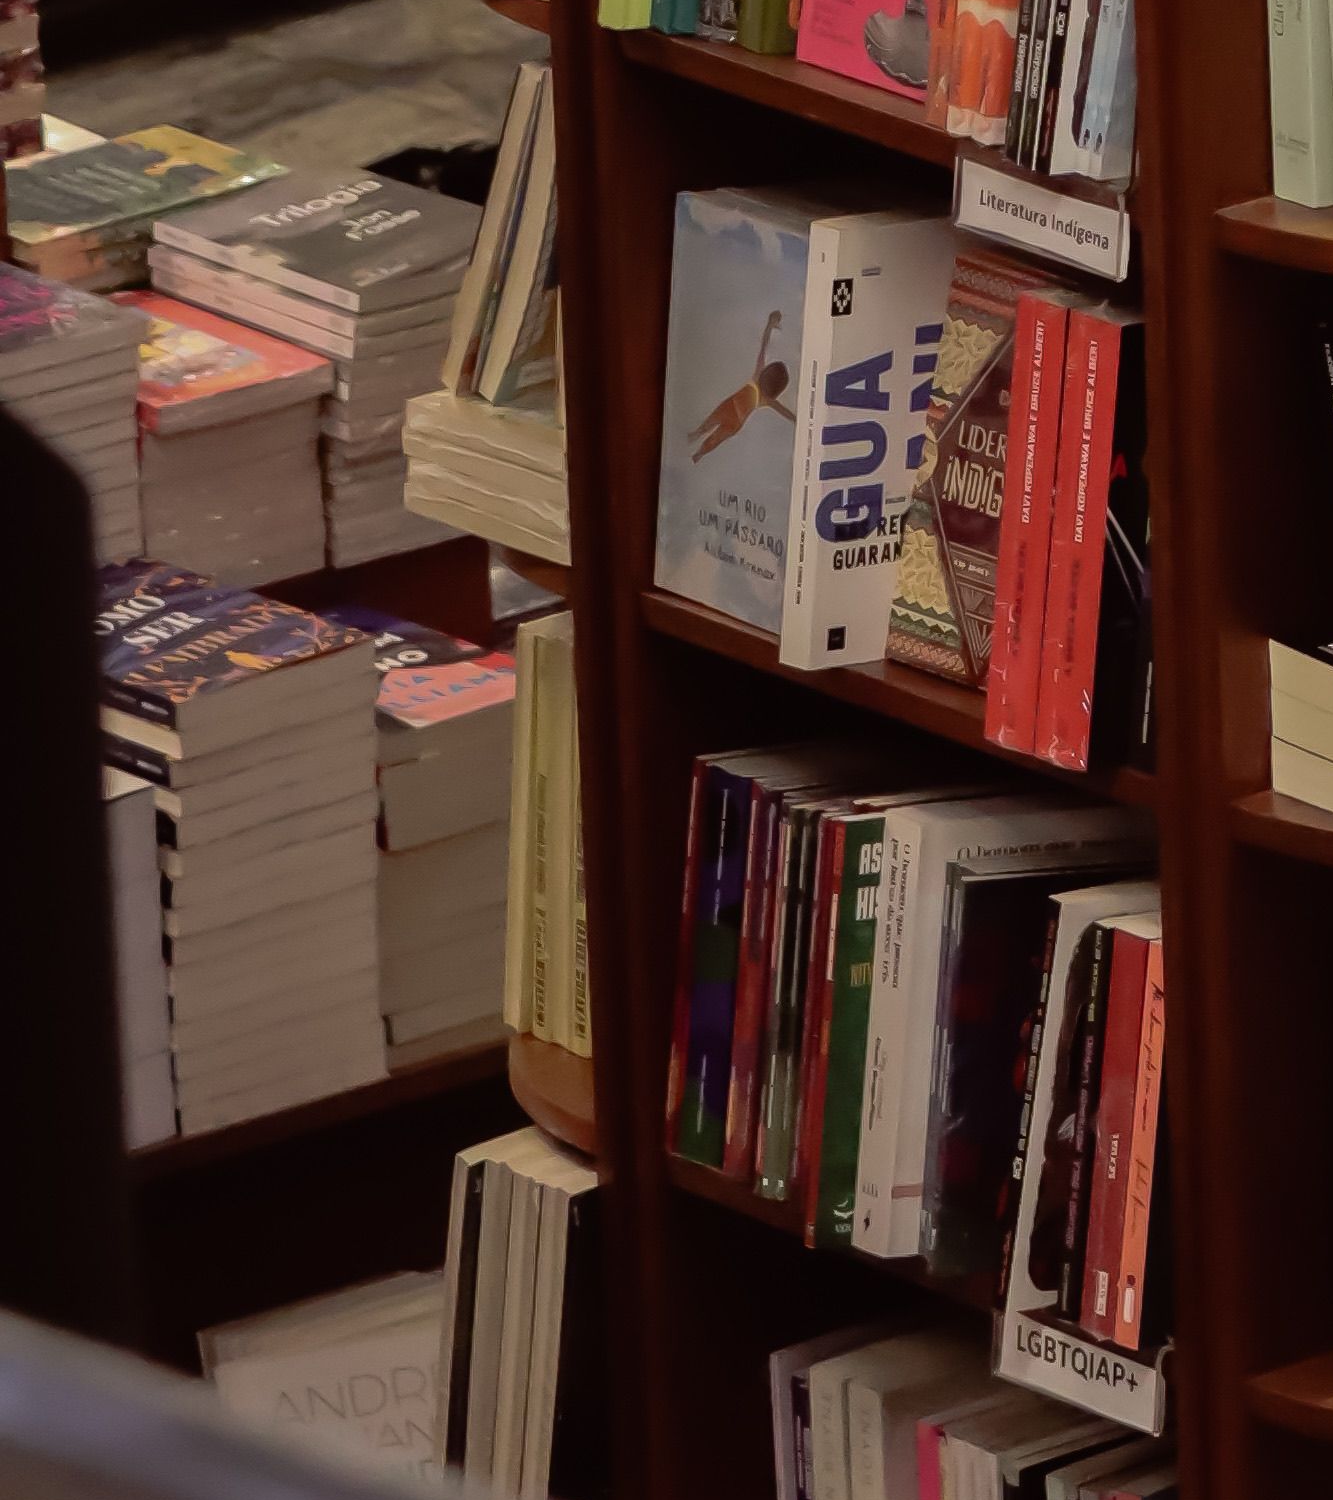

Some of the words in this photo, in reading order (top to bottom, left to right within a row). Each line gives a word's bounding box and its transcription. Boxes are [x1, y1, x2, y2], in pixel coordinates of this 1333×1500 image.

[979, 188, 1048, 228] Literatura
[1050, 213, 1110, 253] Indígena
[959, 419, 1006, 461] LIDER
[1015, 1323, 1139, 1394] LGBTQIAP+
